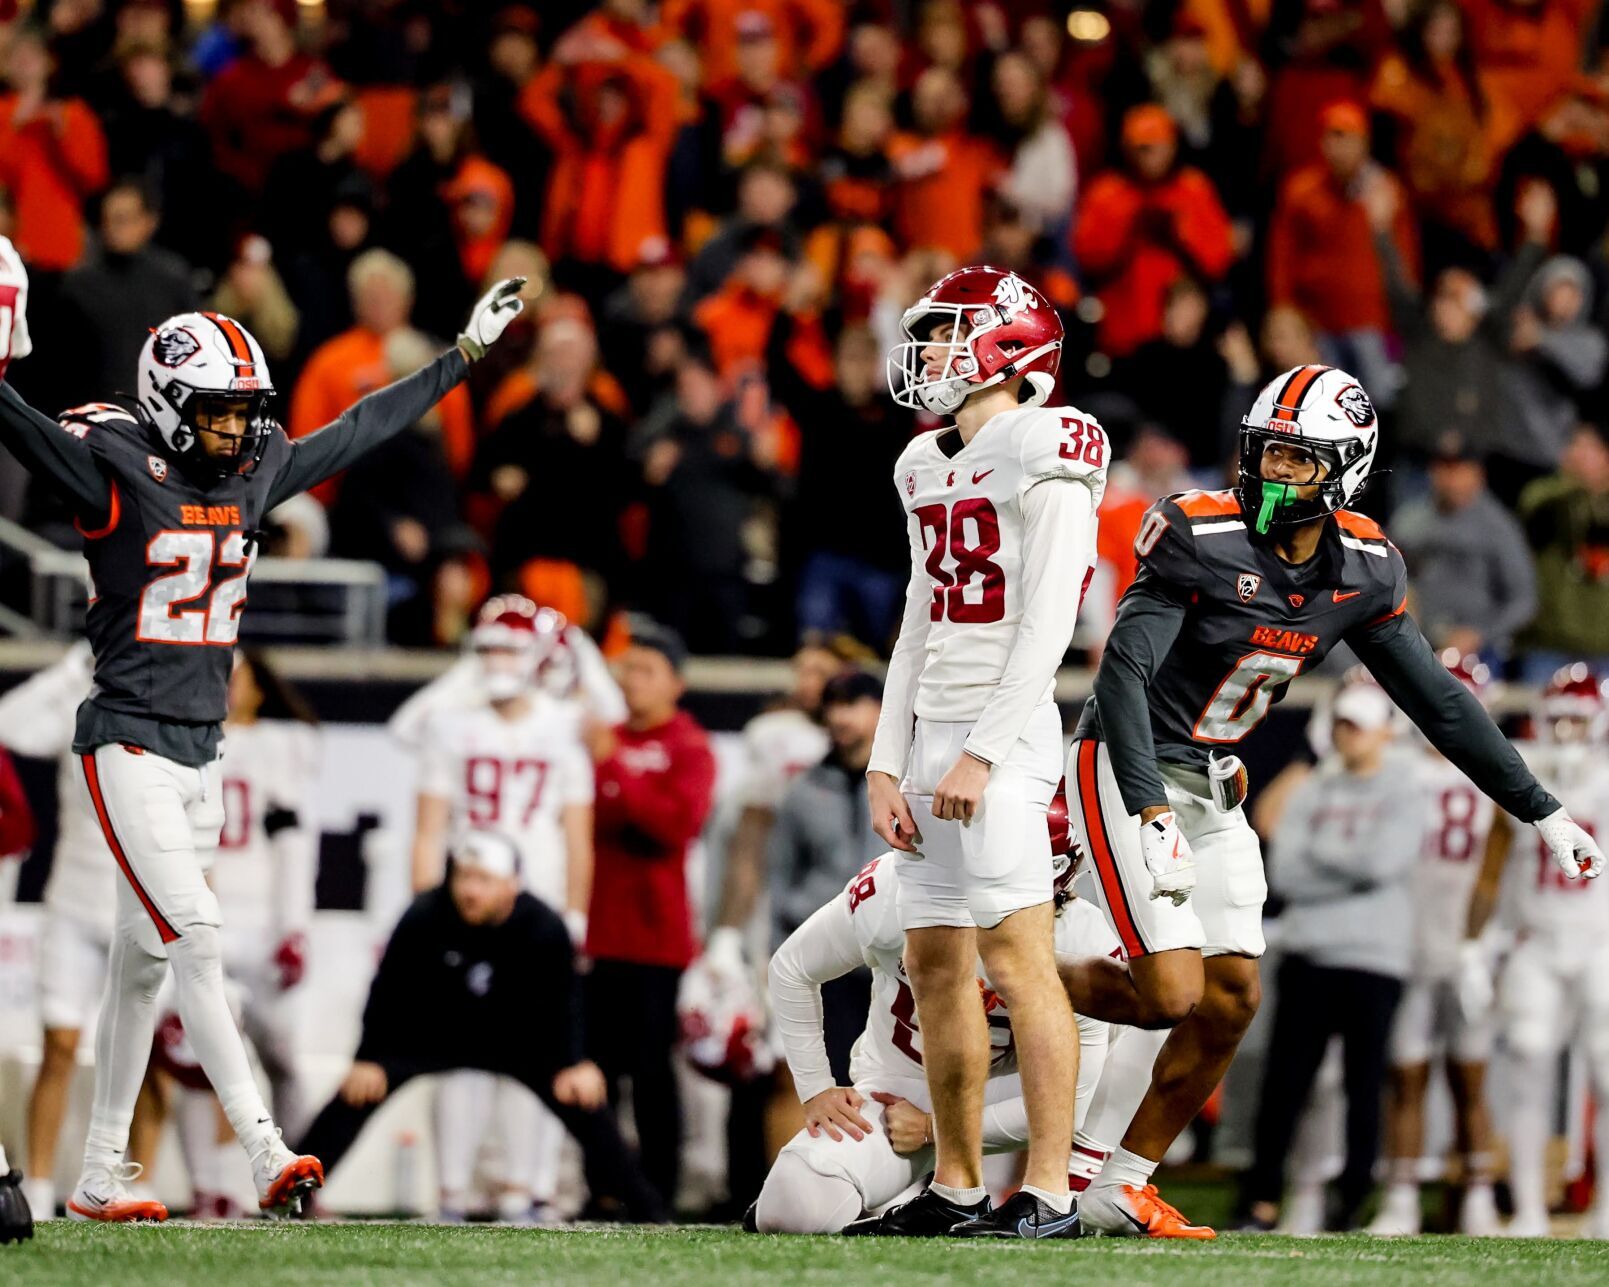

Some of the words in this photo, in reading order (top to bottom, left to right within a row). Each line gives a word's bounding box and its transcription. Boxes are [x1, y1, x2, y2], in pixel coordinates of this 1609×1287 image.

[1058, 416, 1104, 468] 38
[179, 505, 241, 526] BEAVS
[1133, 510, 1169, 558] 0
[911, 497, 1006, 624] 38
[136, 529, 258, 646] 22
[1240, 585, 1254, 597] 12
[1248, 624, 1319, 653] BEAVS
[1191, 649, 1305, 743] 0
[466, 756, 548, 831] 97
